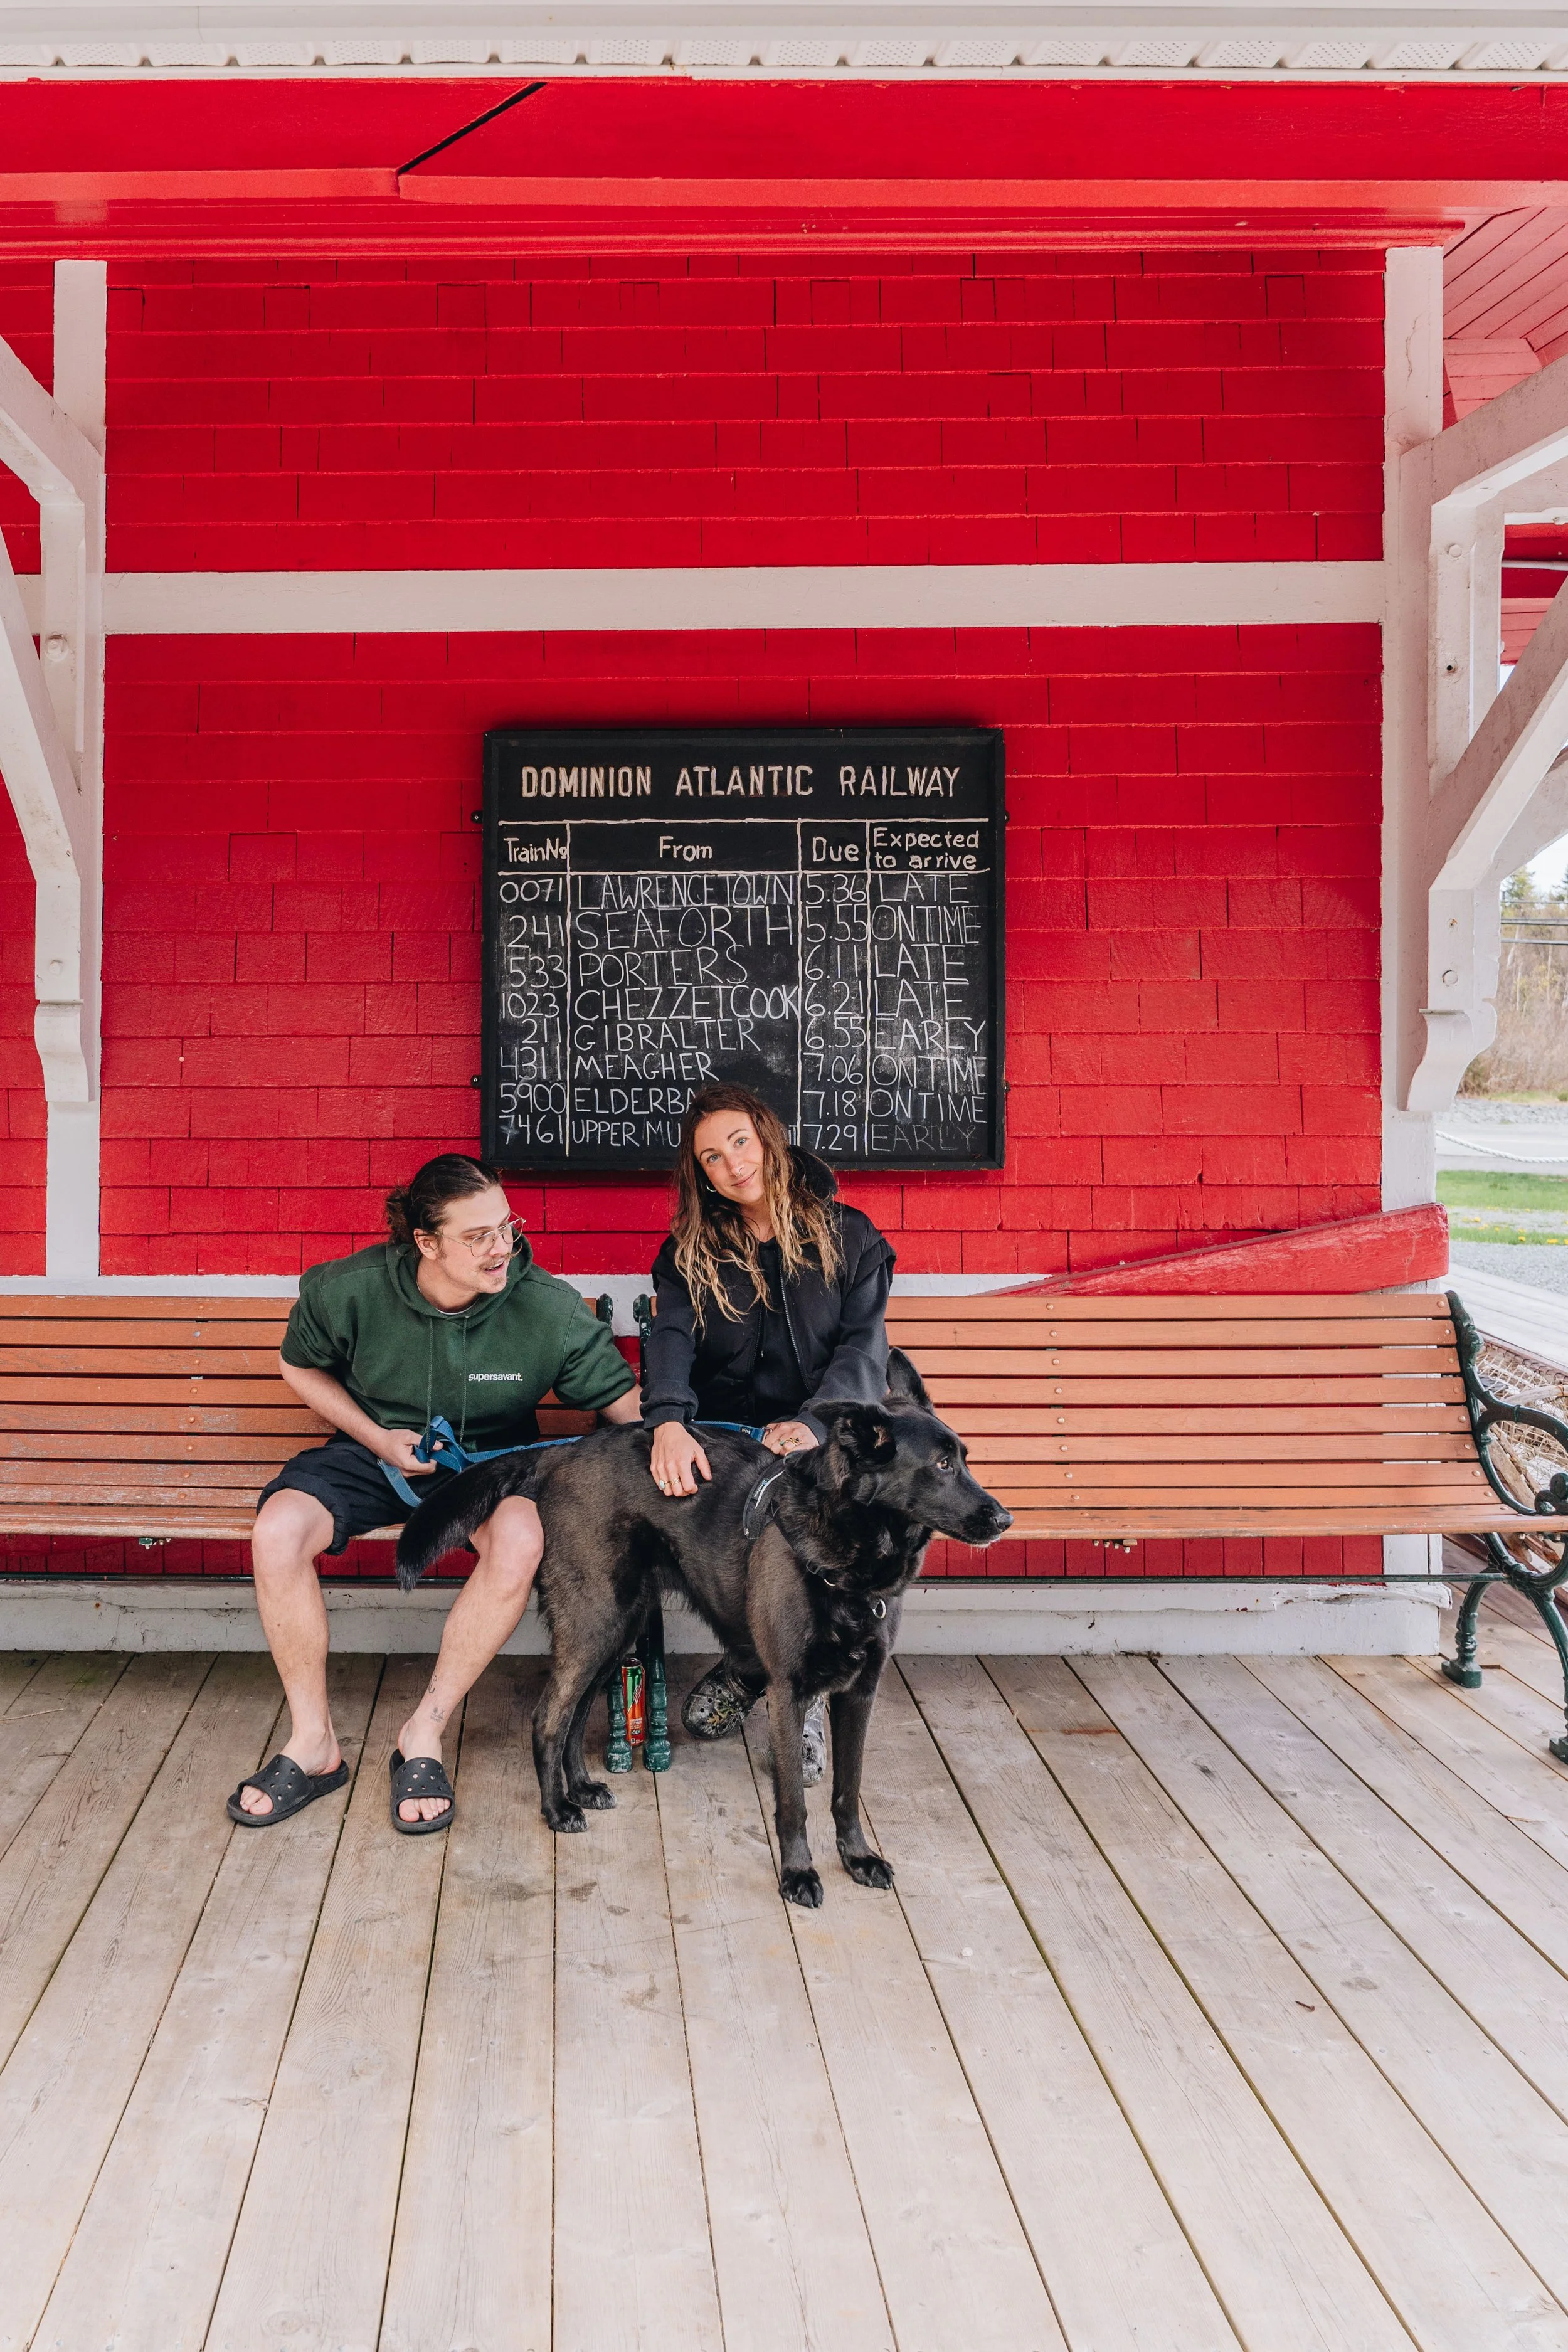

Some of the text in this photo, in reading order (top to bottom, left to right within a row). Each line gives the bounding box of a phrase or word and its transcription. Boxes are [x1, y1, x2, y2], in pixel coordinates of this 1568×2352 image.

[522, 765, 960, 797] DOMINION ATLANTIC RAILWAY
[660, 836, 712, 862] From
[813, 837, 859, 862] Due
[874, 827, 979, 851] Expected
[874, 852, 977, 869] to arrive
[499, 873, 969, 909] 0071 LAWRENCETOWN 5.36 LATE
[507, 915, 564, 948] 241
[576, 905, 793, 950] SEAFORTH
[805, 903, 869, 942] 5.55
[510, 943, 968, 988] 533 PORTERS 6.11 LATE
[502, 978, 972, 1021] 1023 CHEZZETCOOK 6.21 LATE
[522, 1017, 987, 1052] 211 GIBRALTER 6.55 EARLY
[501, 1045, 561, 1081] 4311
[574, 1052, 719, 1081] MEAGHER
[803, 1052, 864, 1084] 7.06
[501, 1083, 566, 1114] 5900
[574, 1087, 696, 1115] ELDERBA
[803, 1090, 857, 1120] 7.18
[499, 1115, 563, 1145] 7461
[571, 1120, 640, 1147] UPPER
[803, 1123, 857, 1151] 7.29
[871, 1124, 976, 1152] EARLY
[468, 1372, 523, 1382] supersavant.
